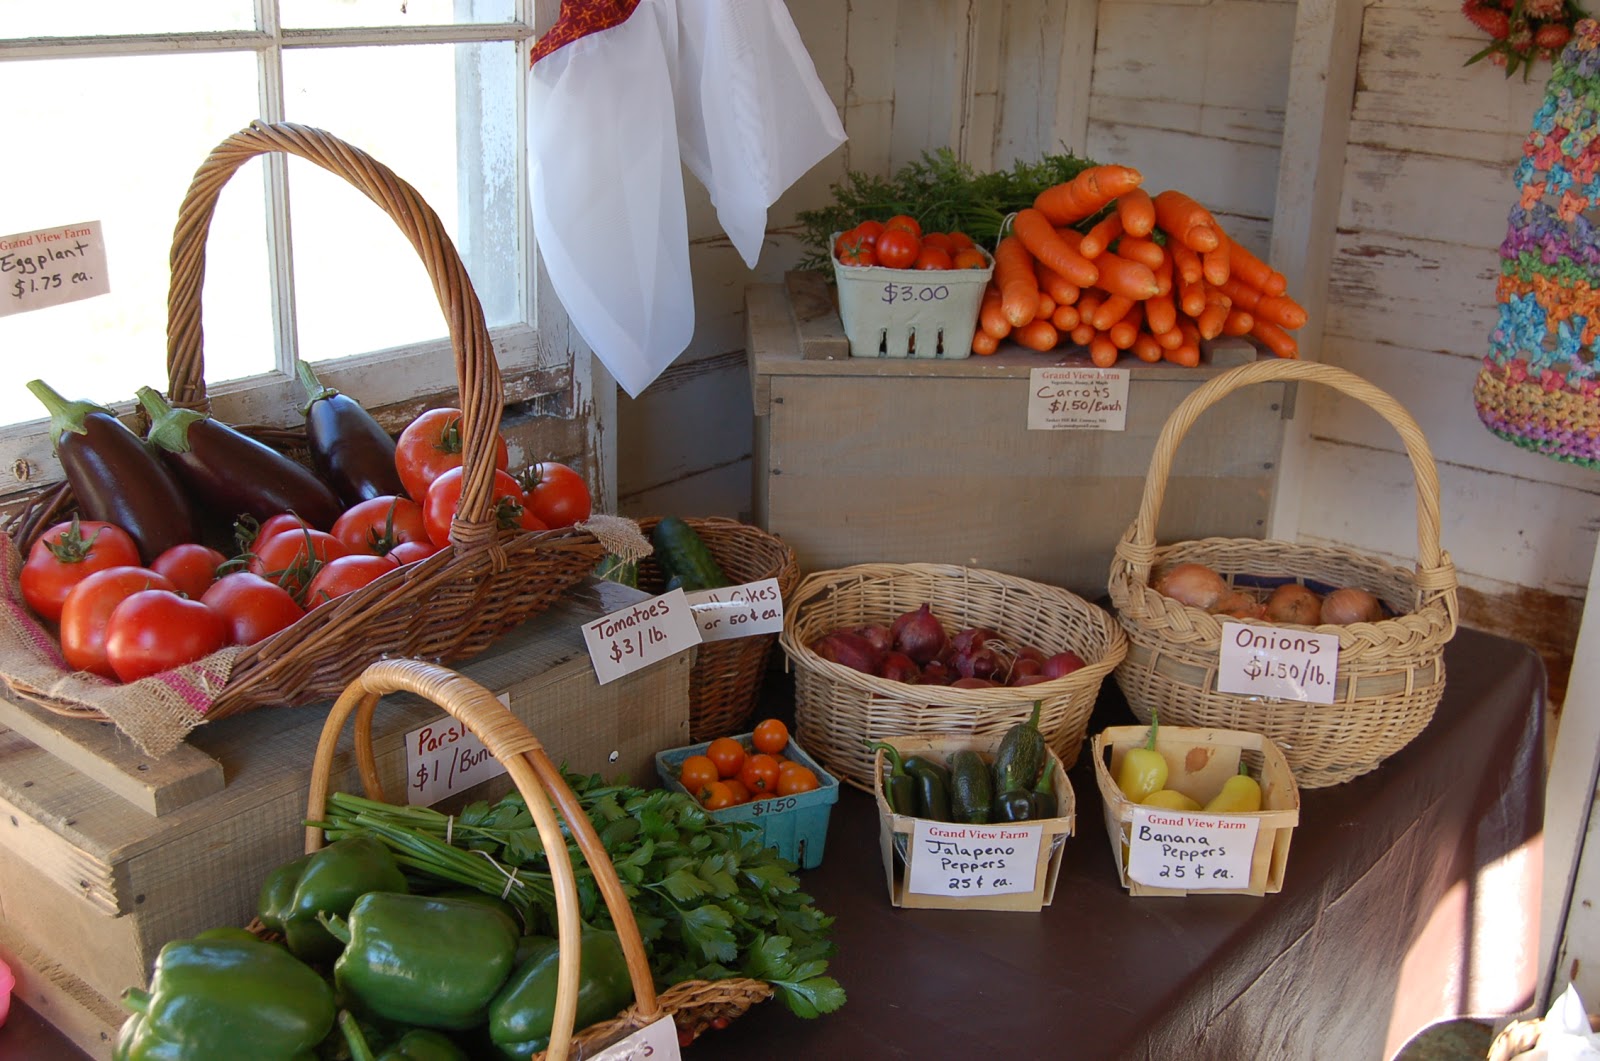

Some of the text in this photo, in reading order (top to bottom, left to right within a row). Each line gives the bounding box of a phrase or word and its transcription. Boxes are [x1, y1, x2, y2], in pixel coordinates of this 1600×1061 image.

[0, 228, 91, 251] Grand View Farm
[0, 241, 89, 275] Eggplant
[12, 272, 93, 300] $1.75 ea.
[881, 282, 949, 305] $3.00
[1042, 371, 1120, 381] Grand View Frm
[1036, 386, 1110, 399] Carrots
[591, 600, 670, 640] Tomatoes
[704, 619, 721, 630] or
[762, 609, 781, 620] ea.
[610, 626, 667, 663] $3/lb.
[1236, 628, 1320, 654] Onions
[1243, 656, 1331, 687] $1.50/lb.
[418, 721, 473, 756] Parsl
[752, 798, 797, 817] $1.50
[1147, 814, 1247, 830] Grand View Farm
[929, 826, 1029, 840] Grand View Farm
[1138, 825, 1210, 846] Banana
[1162, 844, 1226, 862] Peppers
[941, 857, 1006, 874] Peppers
[1212, 868, 1234, 879] ea.
[992, 878, 1012, 888] ea.
